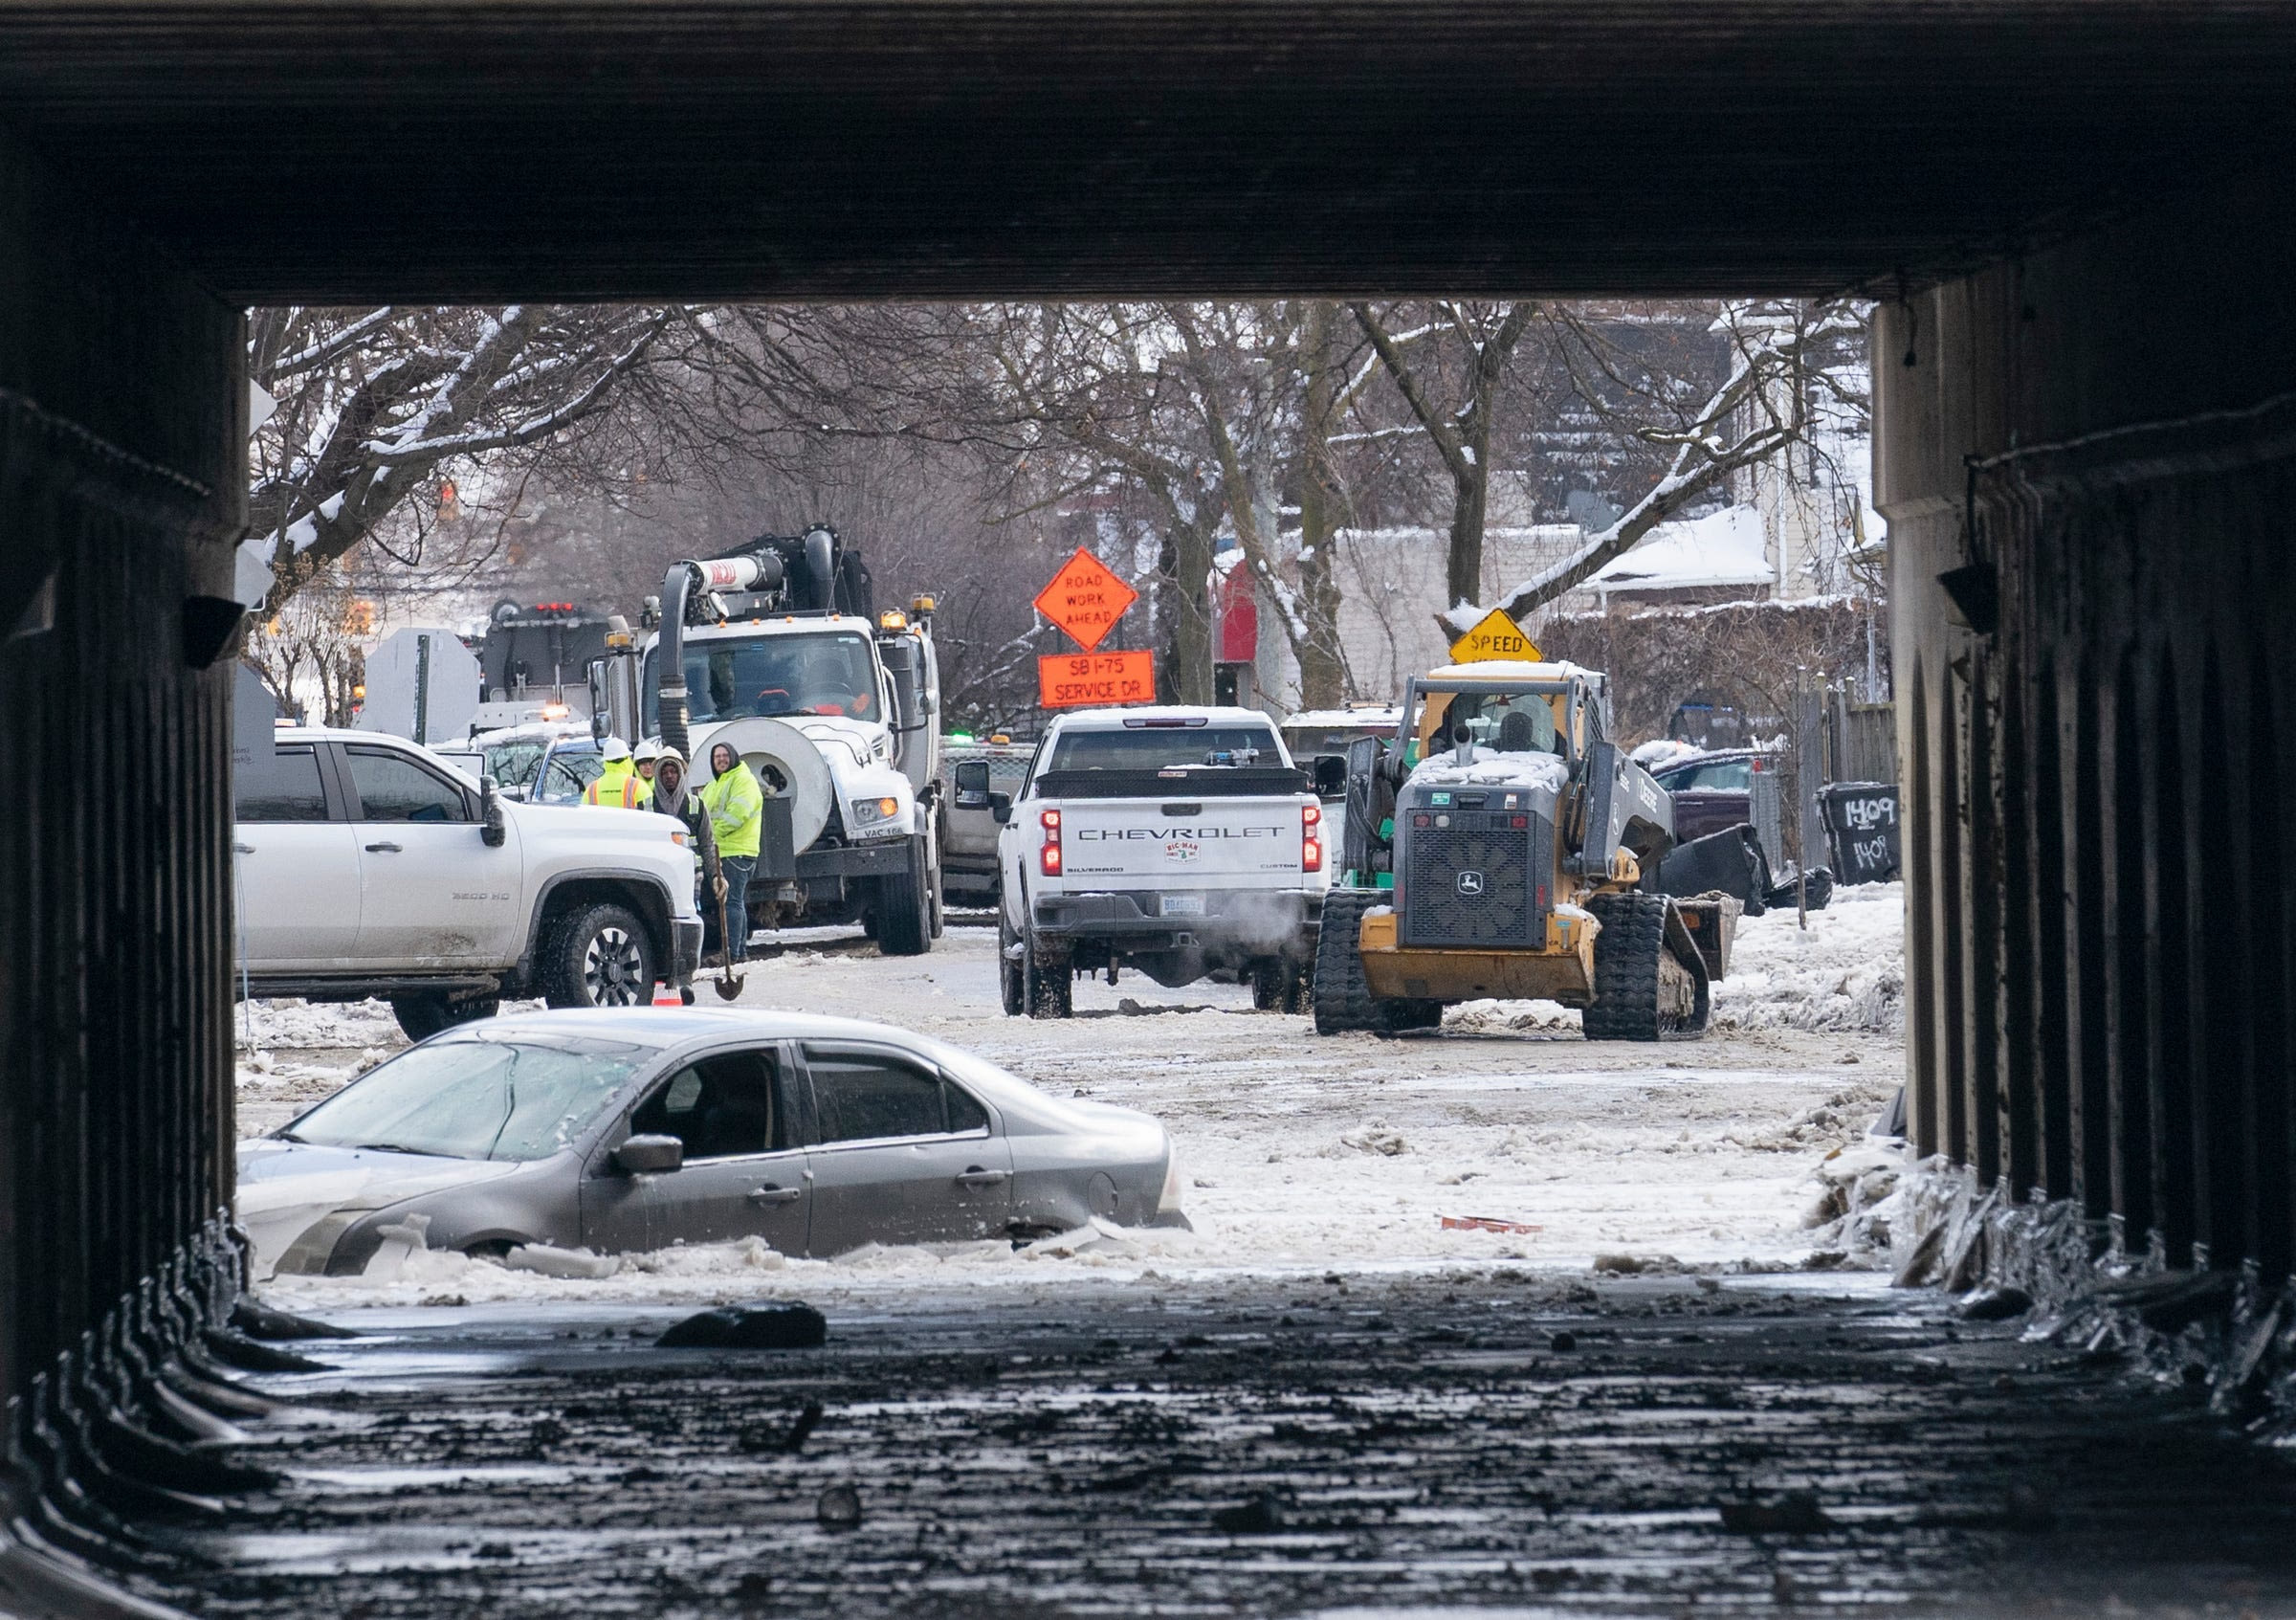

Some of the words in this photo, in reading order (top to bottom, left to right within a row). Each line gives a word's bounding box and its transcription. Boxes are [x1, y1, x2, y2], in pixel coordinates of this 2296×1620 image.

[1066, 575, 1102, 588] ROAD
[1067, 593, 1104, 607] WORK
[1066, 610, 1111, 625] AHEAD
[1470, 635, 1522, 653] SPEED
[1070, 659, 1090, 676] SB
[1094, 658, 1124, 674] I-75
[1055, 681, 1115, 700] SERVICE
[1121, 680, 1140, 697] DR
[1845, 797, 1894, 828] 1409
[865, 830, 884, 838] VAC
[1078, 827, 1285, 840] CHEVROLET
